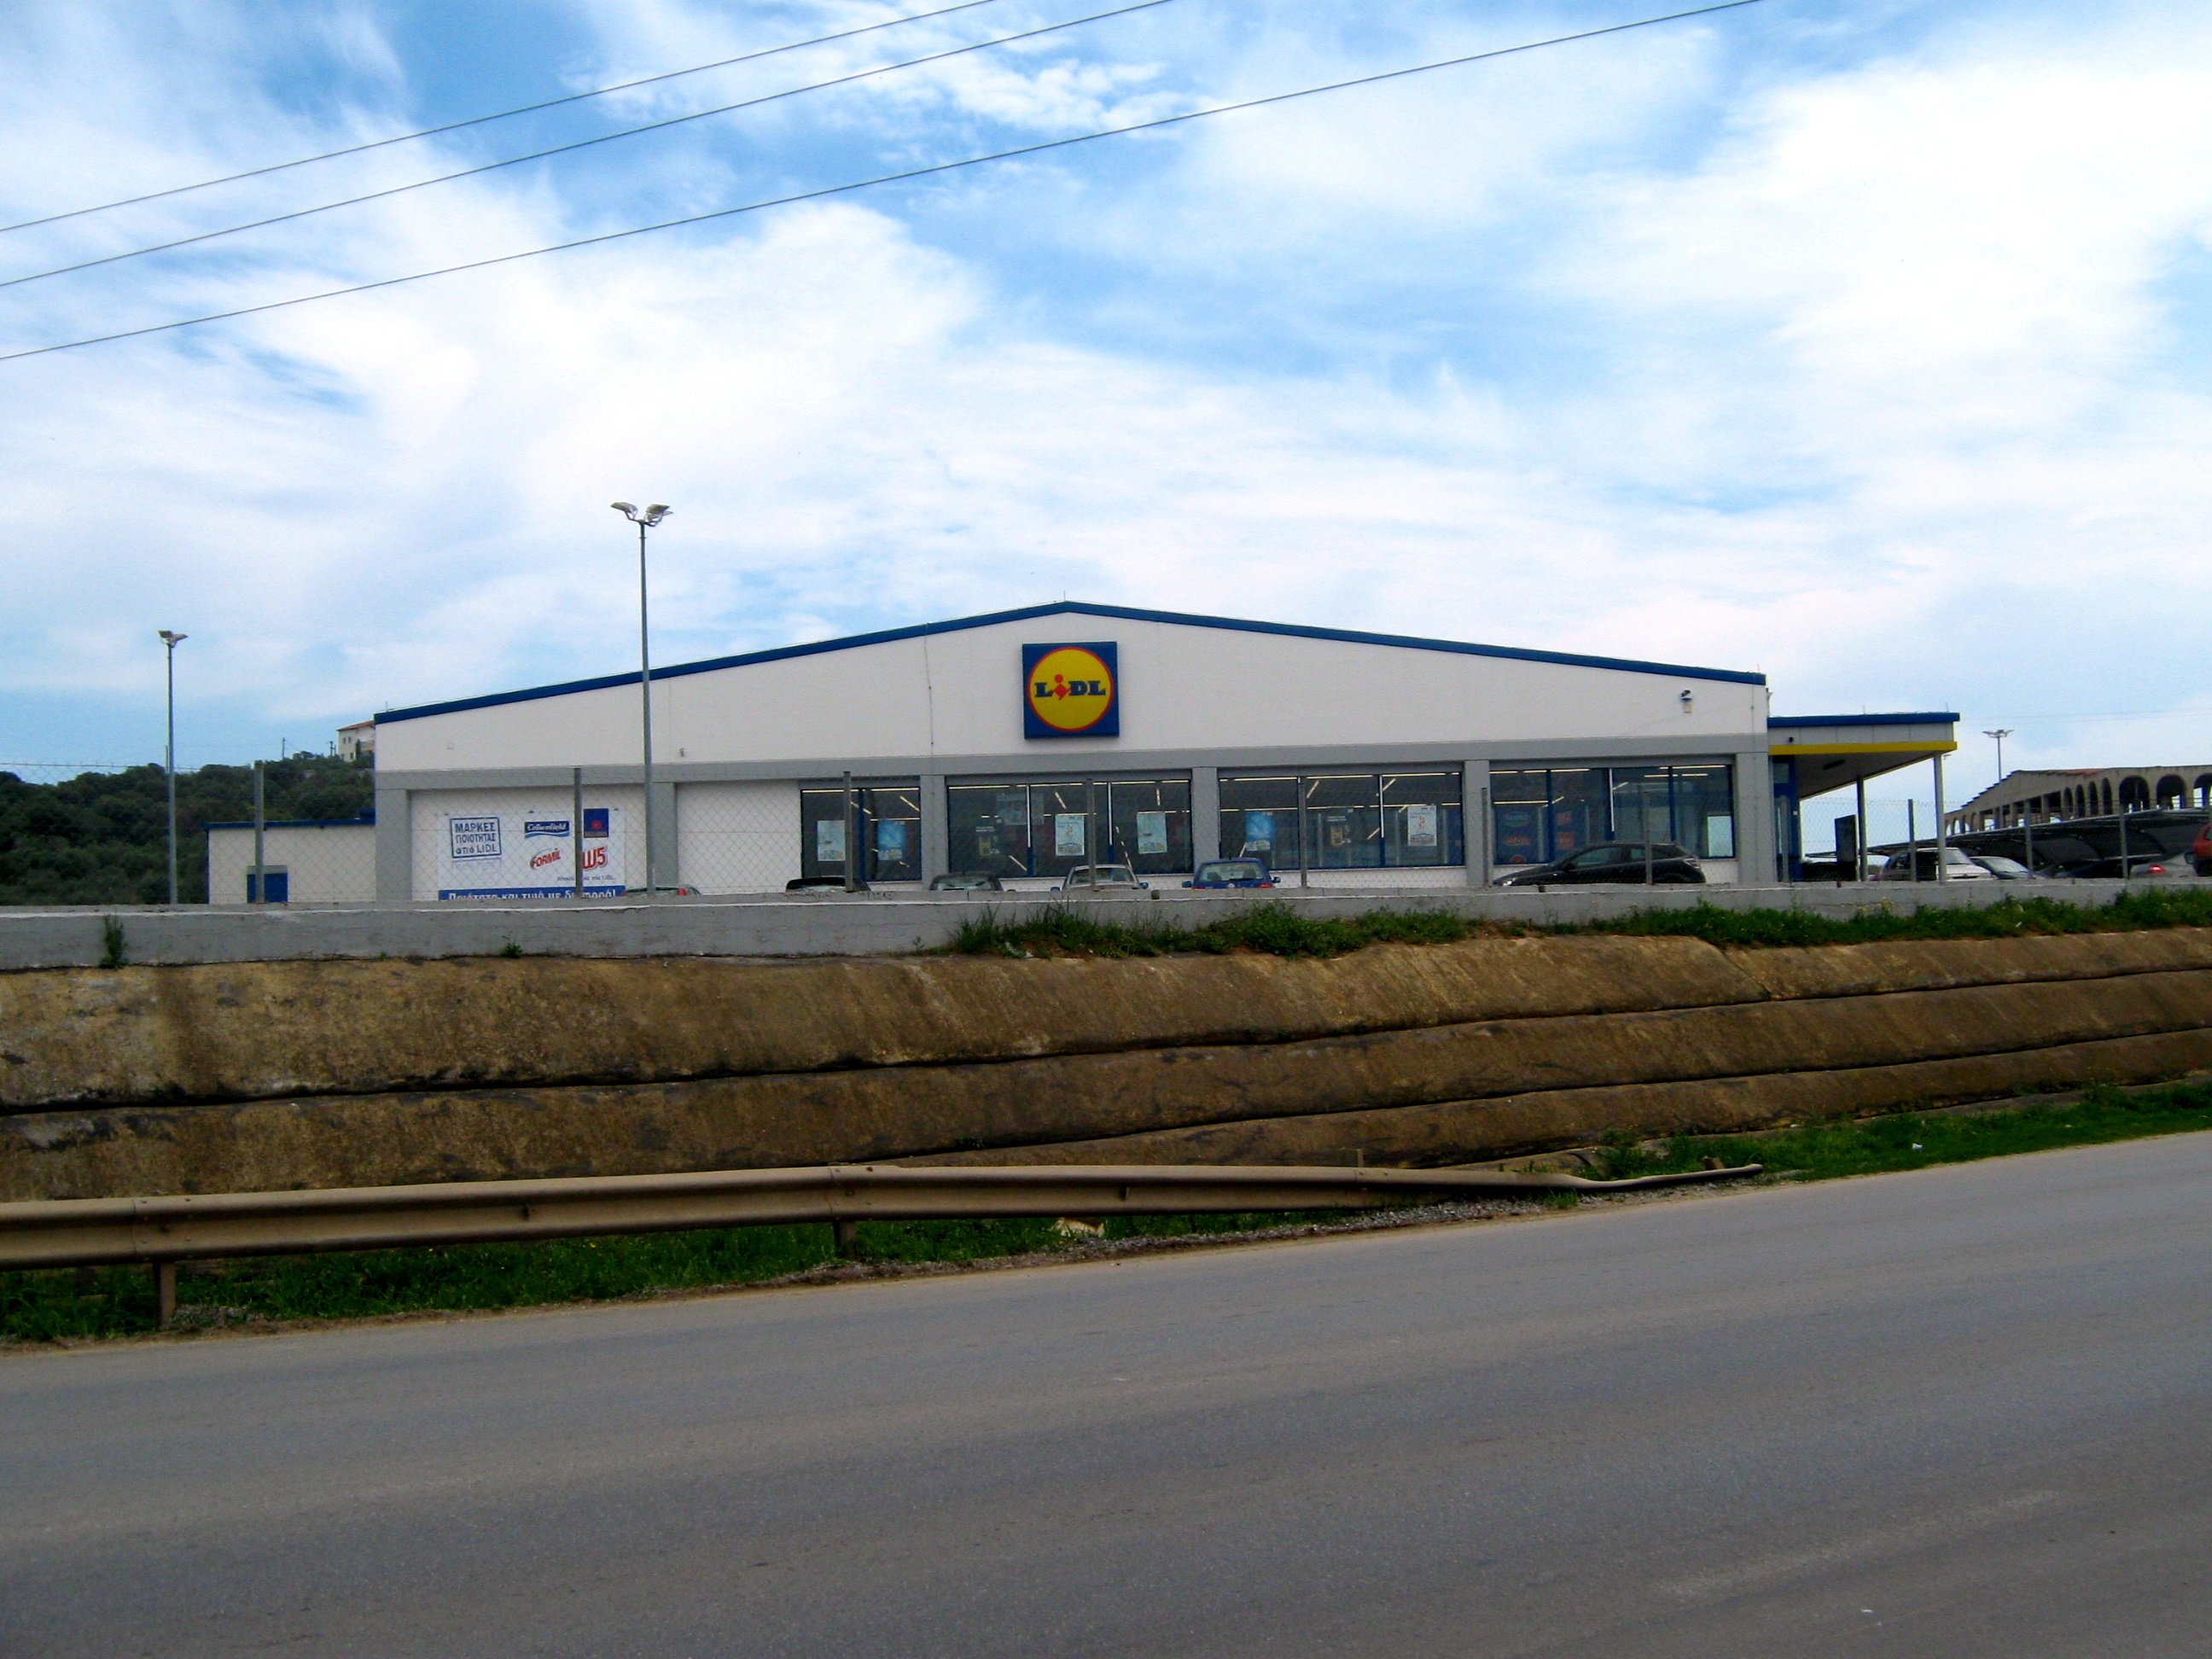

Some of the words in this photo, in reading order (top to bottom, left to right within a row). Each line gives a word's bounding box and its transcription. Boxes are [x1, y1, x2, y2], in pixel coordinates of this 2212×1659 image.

[455, 822, 496, 833] ΜΑΡΚΕΣ
[456, 833, 496, 843] ΠΟΙΟΤΗΤΑΣ
[476, 843, 498, 853] LIDL
